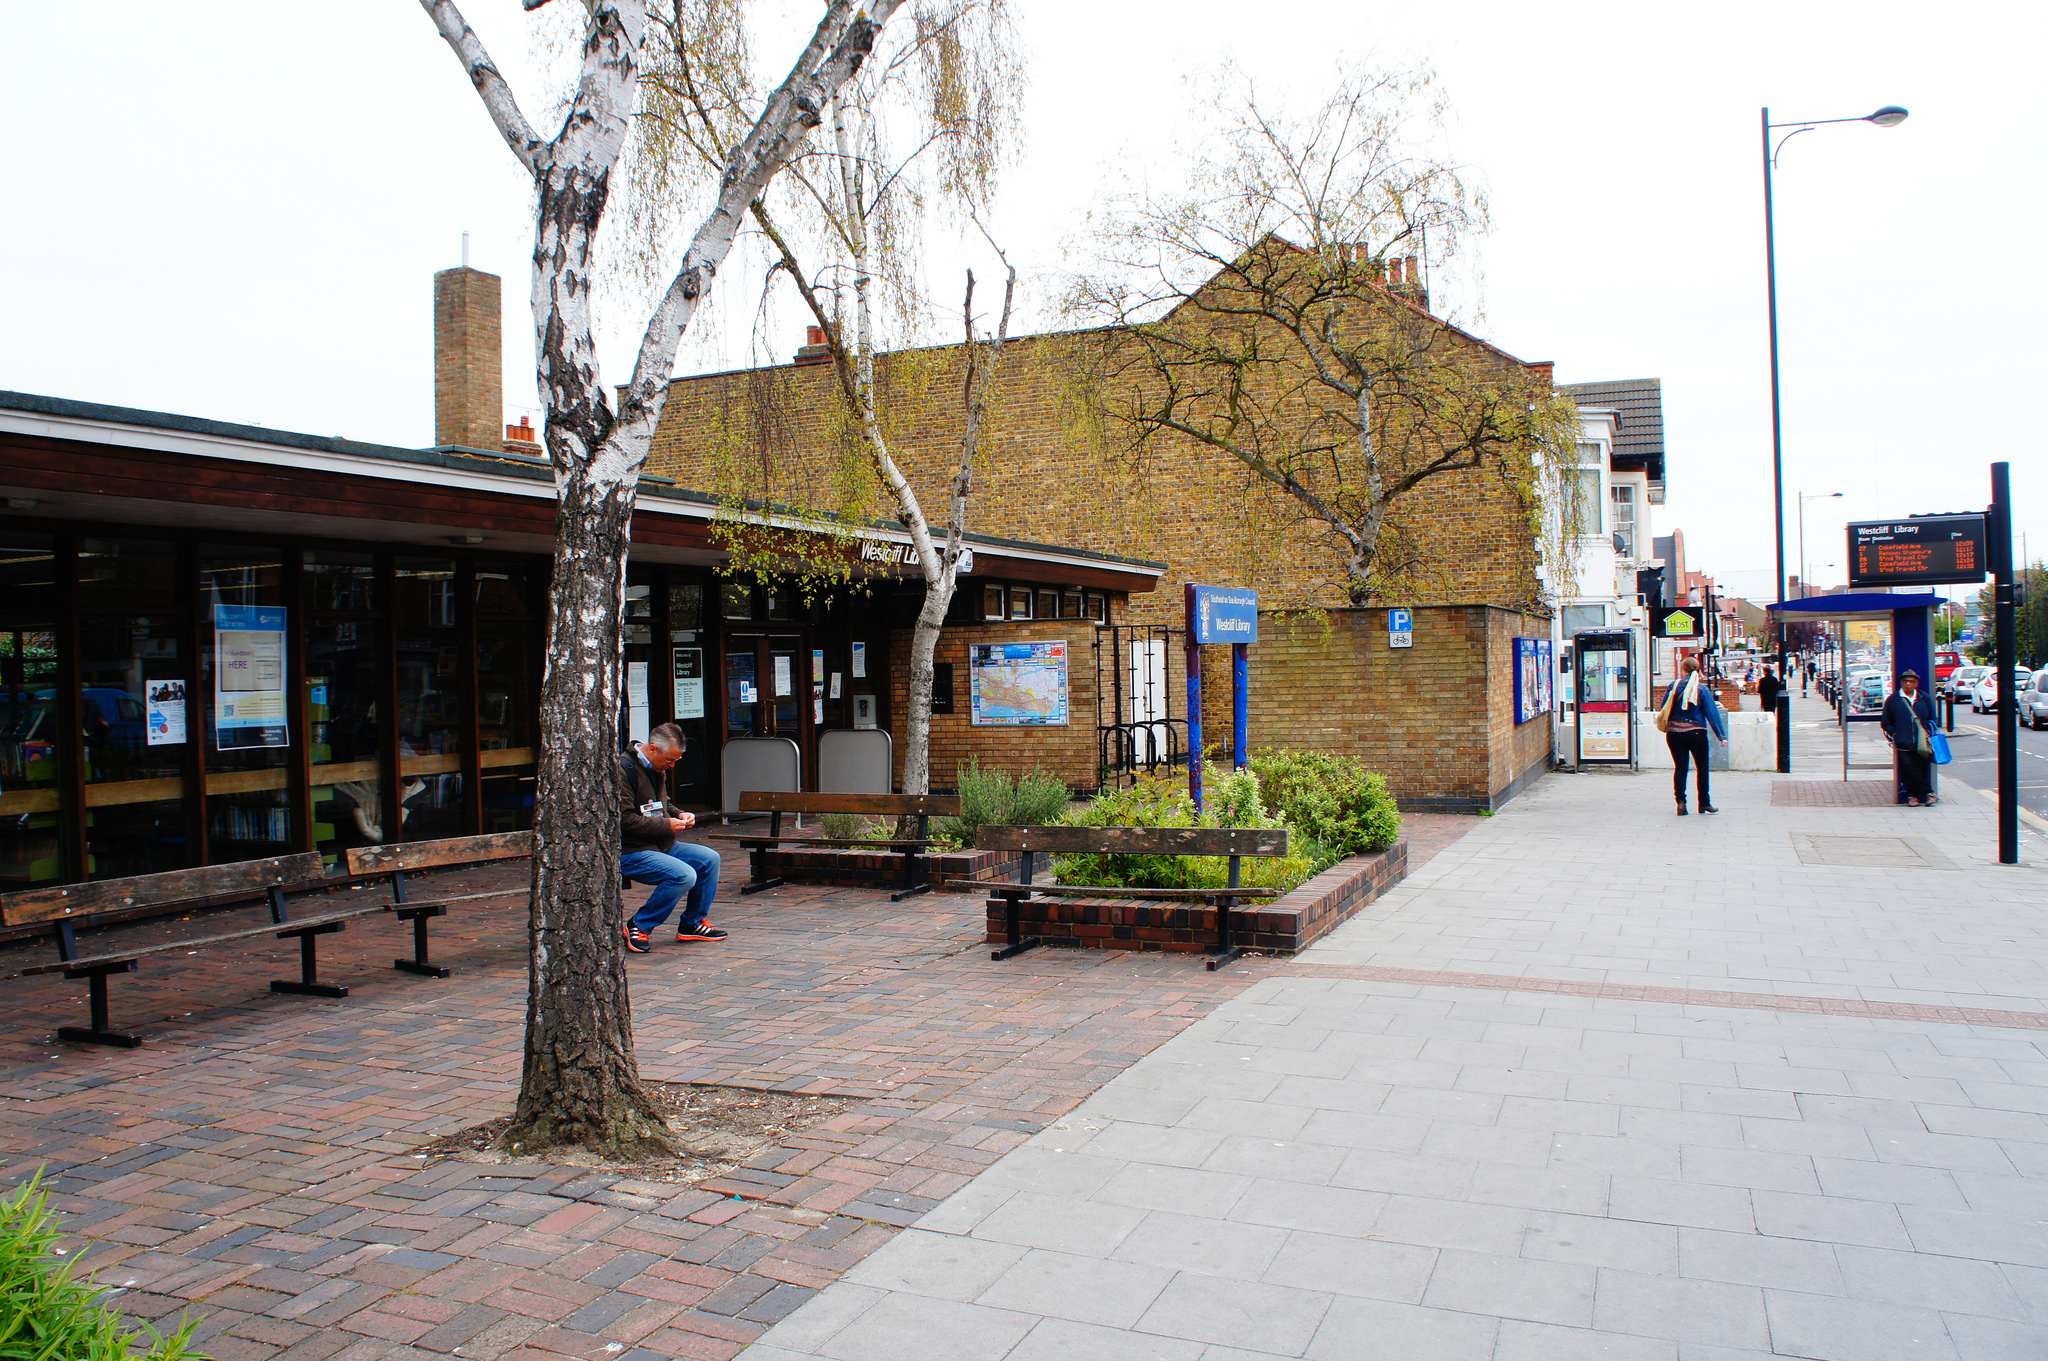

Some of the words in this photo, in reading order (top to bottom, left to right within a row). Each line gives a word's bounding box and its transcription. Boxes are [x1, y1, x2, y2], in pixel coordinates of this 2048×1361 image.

[1858, 526, 1890, 535] Westcliff
[1894, 525, 1919, 534] Library
[861, 541, 904, 563] Westciff
[1216, 618, 1235, 631] Westcliff
[1236, 619, 1251, 634] Library
[1395, 611, 1408, 630] P
[229, 660, 248, 669] HERE
